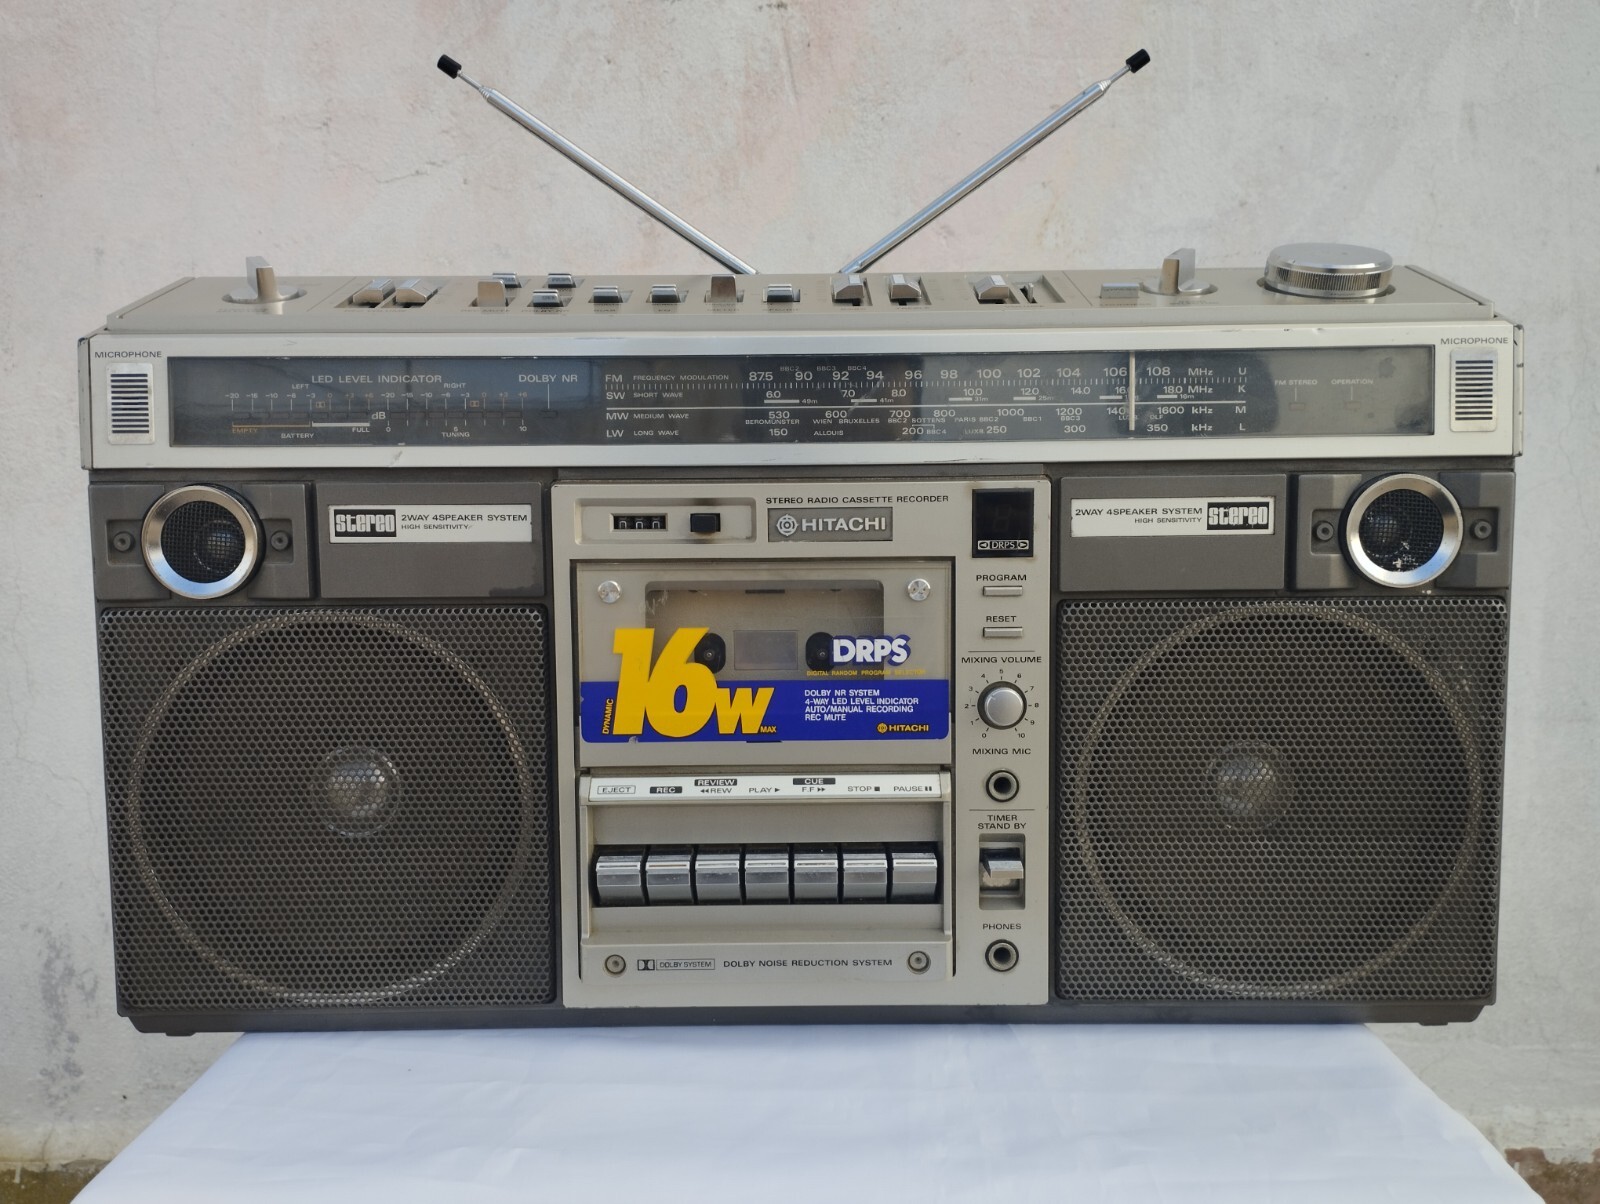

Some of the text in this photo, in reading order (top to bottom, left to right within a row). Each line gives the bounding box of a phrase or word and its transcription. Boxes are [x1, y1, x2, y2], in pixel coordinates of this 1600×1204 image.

[1440, 337, 1508, 345] MICROPHONE
[378, 375, 442, 383] INDICATOR
[795, 367, 1247, 381] 90 92 94 96 98 100 102 104 106 108 MHz U
[371, 412, 386, 420] dB
[1157, 406, 1185, 415] 1600
[1192, 406, 1213, 414] kHz
[1064, 425, 1086, 433] 300
[1208, 507, 1268, 525] stereo
[335, 514, 395, 533] stereo
[802, 517, 886, 531] HITACHI
[833, 638, 907, 663] DRPS
[602, 698, 614, 734] DYNAMIC
